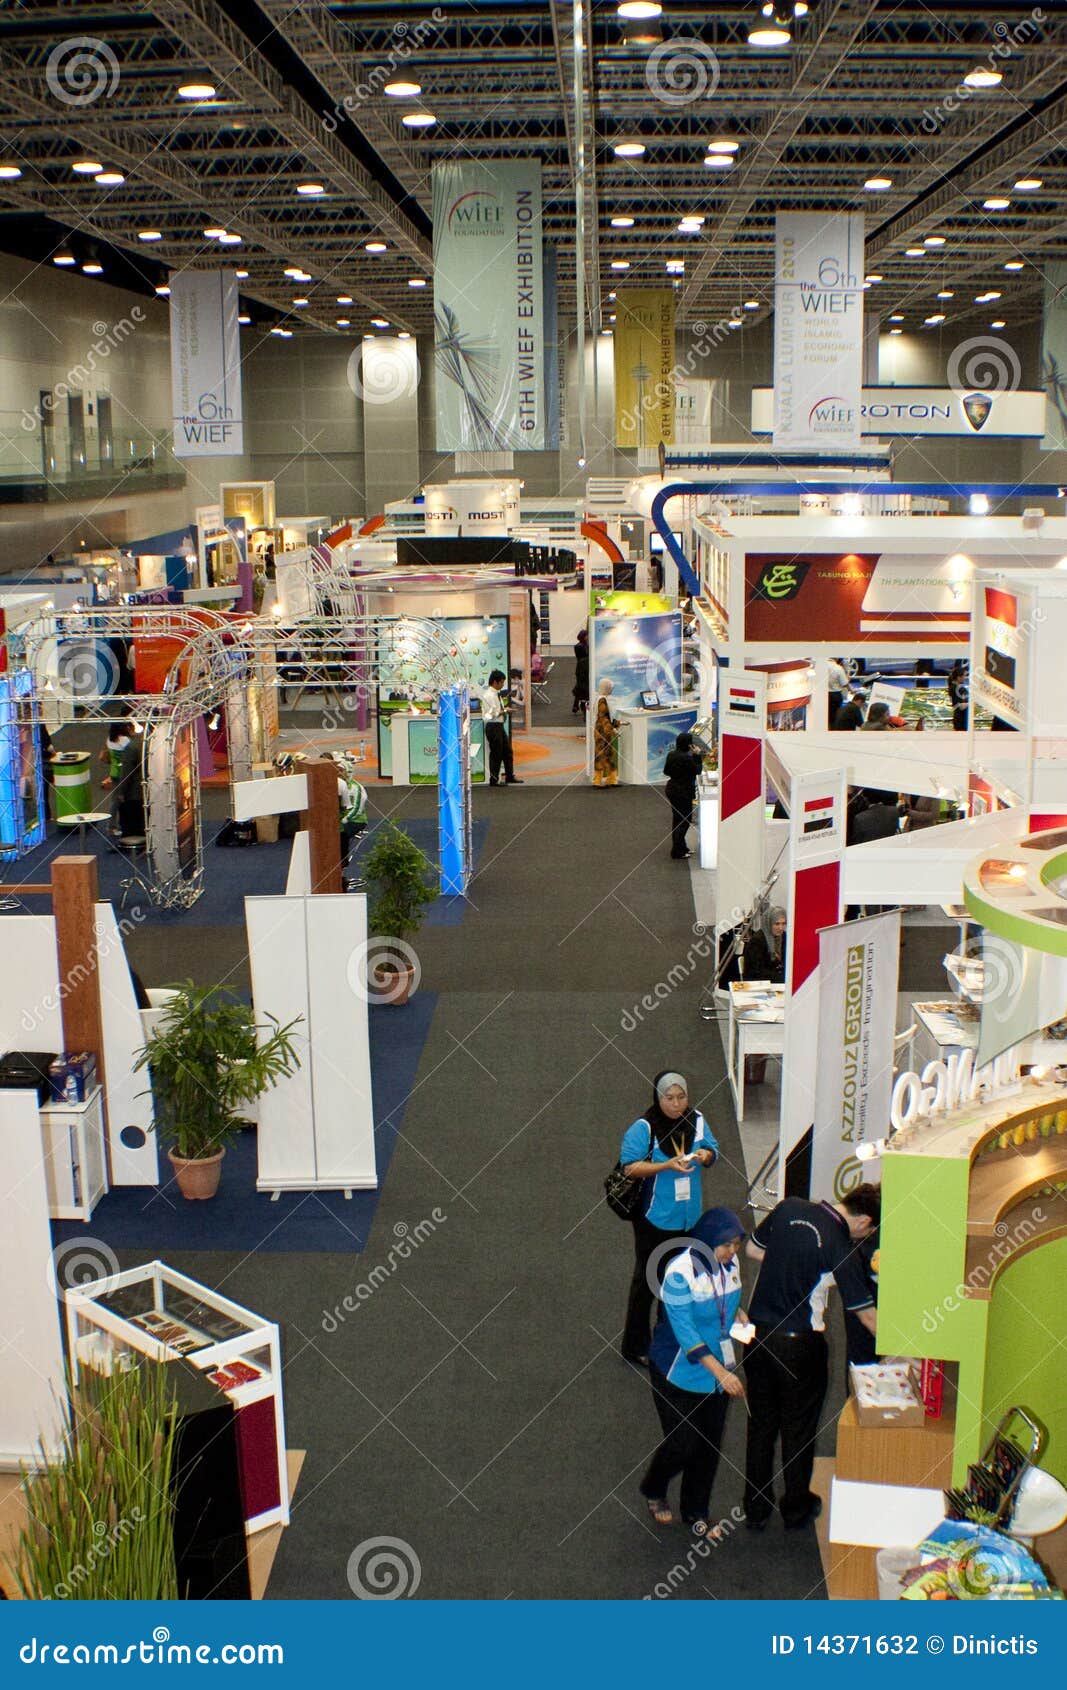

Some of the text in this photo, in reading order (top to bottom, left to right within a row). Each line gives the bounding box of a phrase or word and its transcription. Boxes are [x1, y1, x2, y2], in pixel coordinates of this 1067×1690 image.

[800, 257, 857, 291] the 6th
[517, 190, 535, 431] 6TH WIEF EXHIBITION
[801, 293, 856, 313] WIEF
[660, 304, 671, 375] EXHIBITION
[782, 238, 795, 433] KUALA LUMPUR 2010
[183, 393, 233, 424] the 6th
[861, 404, 950, 418] ROTON
[183, 425, 233, 443] WIEF
[661, 416, 671, 437] 6TH
[840, 951, 864, 1143] AZZOUZ GROUP
[855, 1091, 868, 1142] Reality
